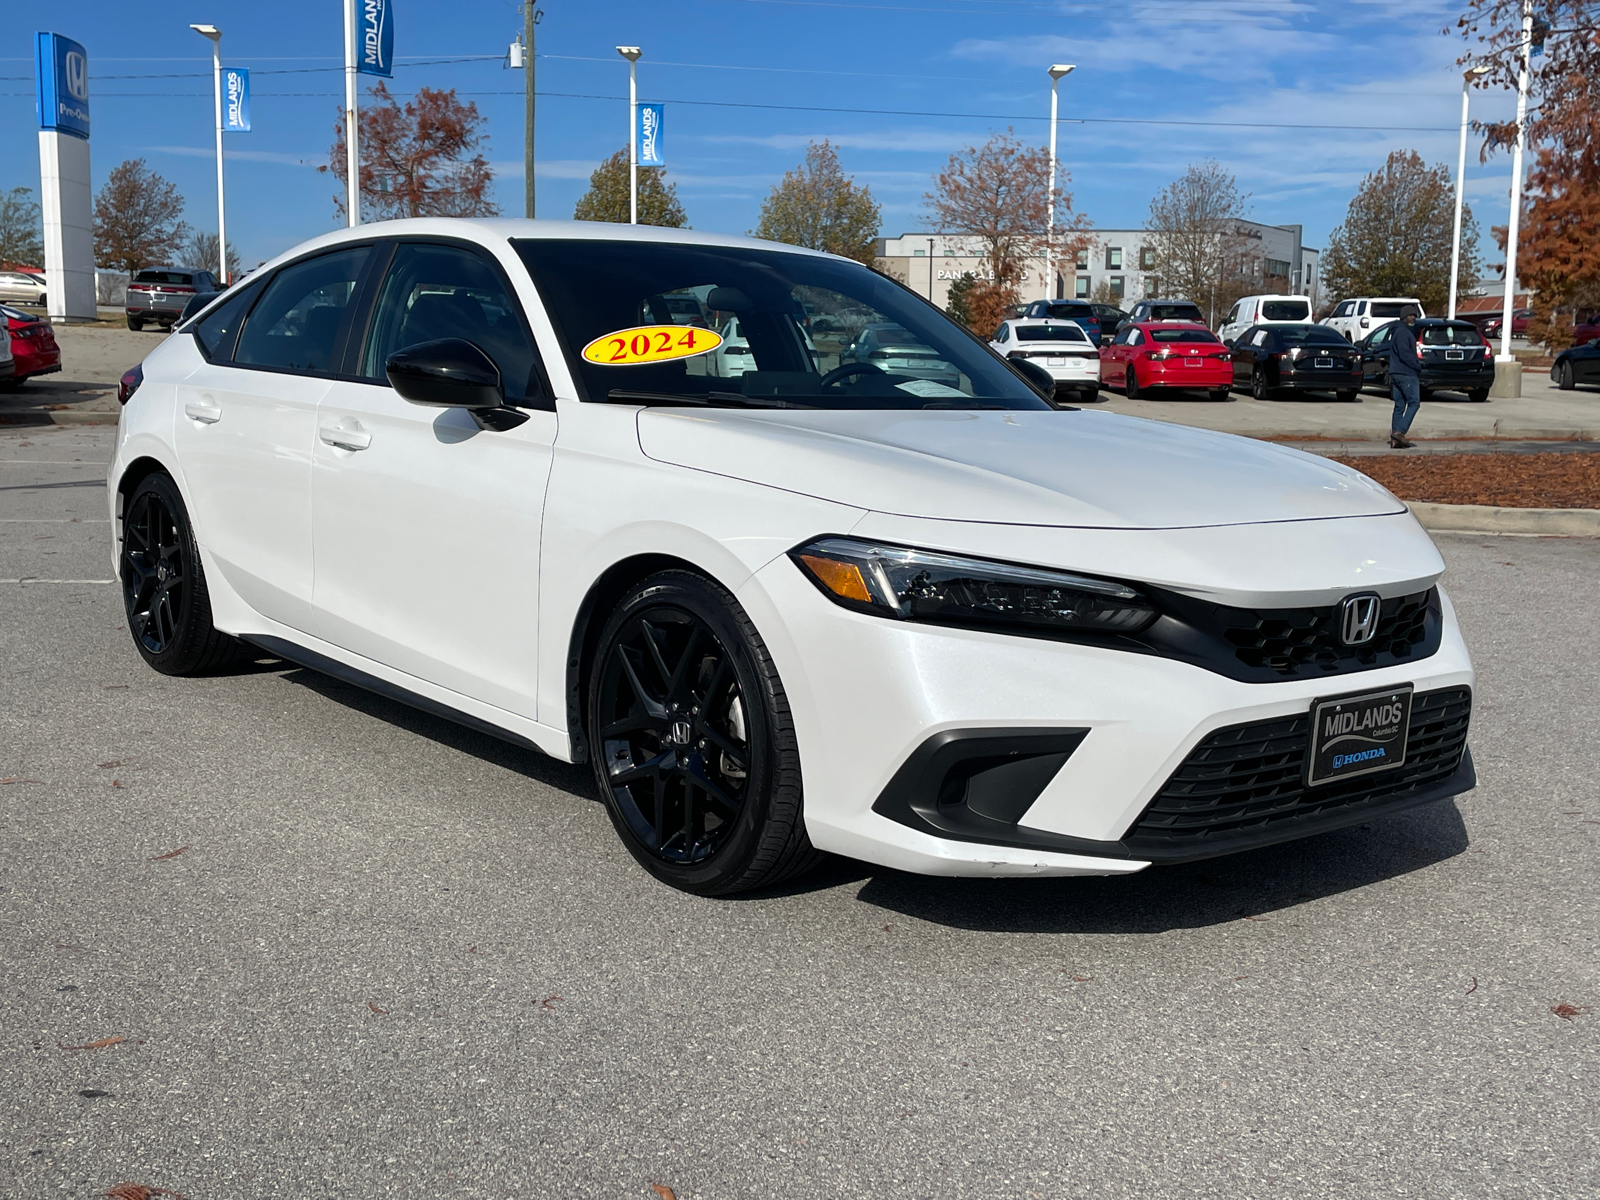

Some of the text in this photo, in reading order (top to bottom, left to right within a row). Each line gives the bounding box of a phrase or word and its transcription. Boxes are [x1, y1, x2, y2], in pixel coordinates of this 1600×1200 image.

[228, 72, 238, 126] MIDLANDS
[643, 107, 652, 160] MIDLANDS
[608, 329, 697, 361] 2024
[1325, 702, 1403, 737] MIDLANDS
[1343, 747, 1386, 765] HONDA
